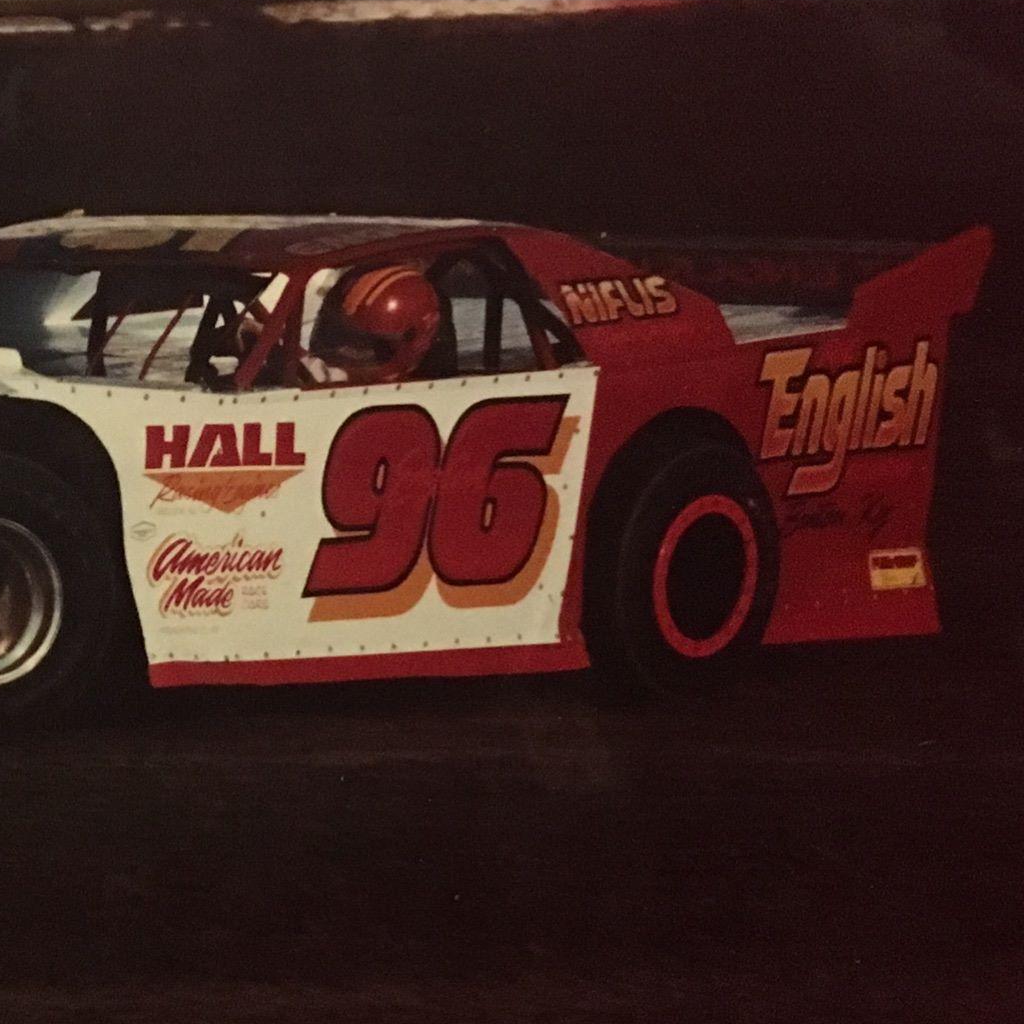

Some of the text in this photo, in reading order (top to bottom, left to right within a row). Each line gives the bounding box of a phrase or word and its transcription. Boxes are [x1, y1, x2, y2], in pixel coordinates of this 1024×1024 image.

[759, 340, 938, 496] English
[144, 422, 306, 470] HALL
[301, 393, 572, 601] 96
[151, 536, 284, 582] American
[163, 576, 235, 613] Made
